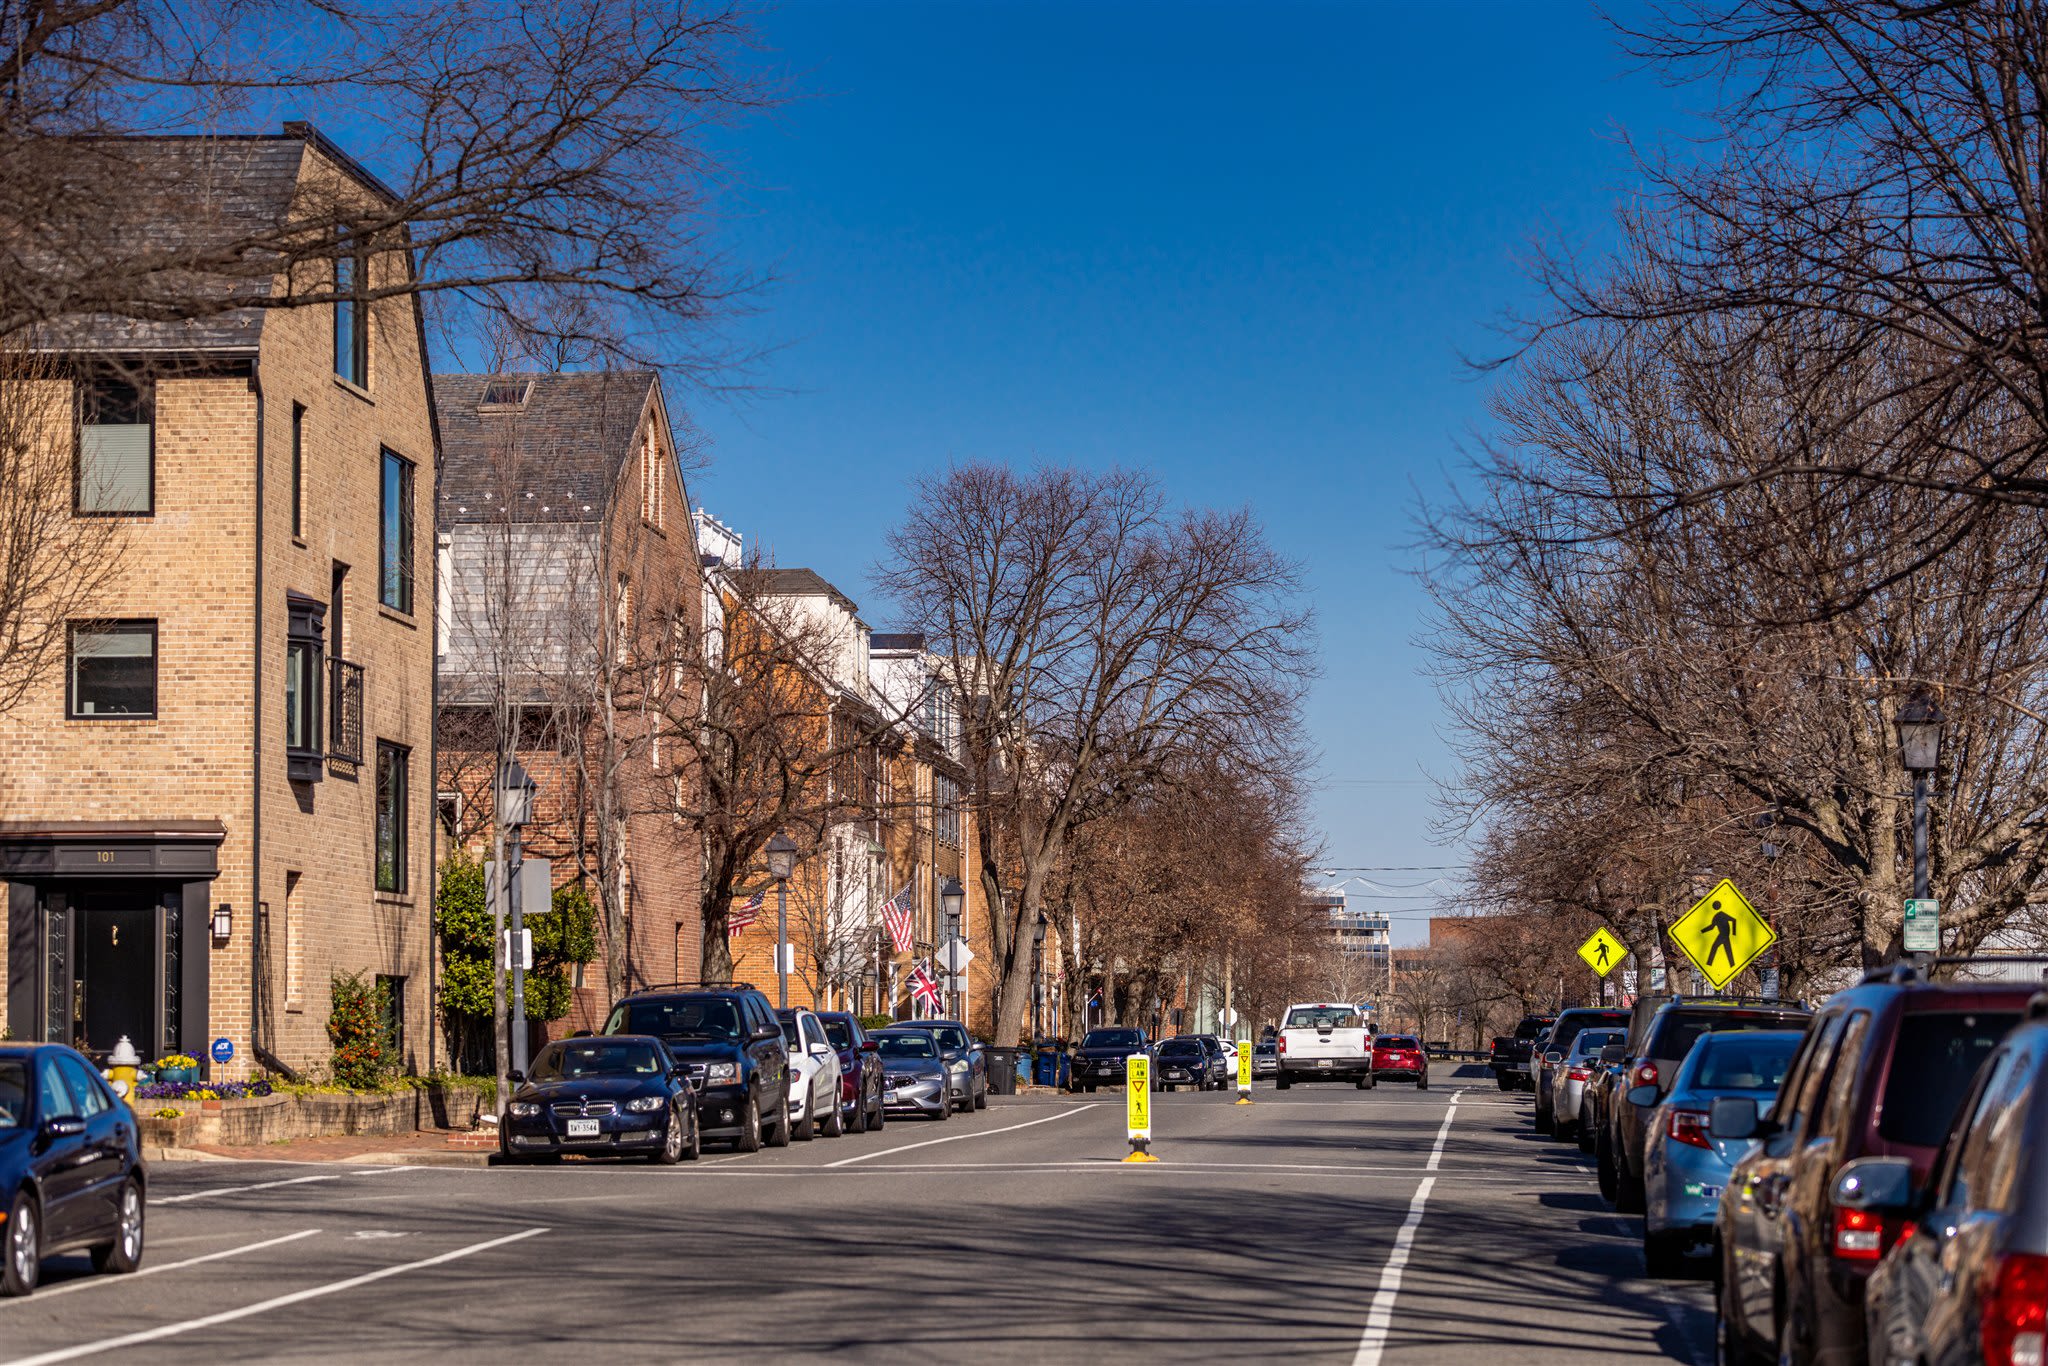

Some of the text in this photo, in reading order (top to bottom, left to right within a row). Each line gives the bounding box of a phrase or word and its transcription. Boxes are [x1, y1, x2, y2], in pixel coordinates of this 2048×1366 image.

[97, 851, 114, 862] 101
[1907, 903, 1914, 916] 2
[216, 1042, 229, 1050] ADT
